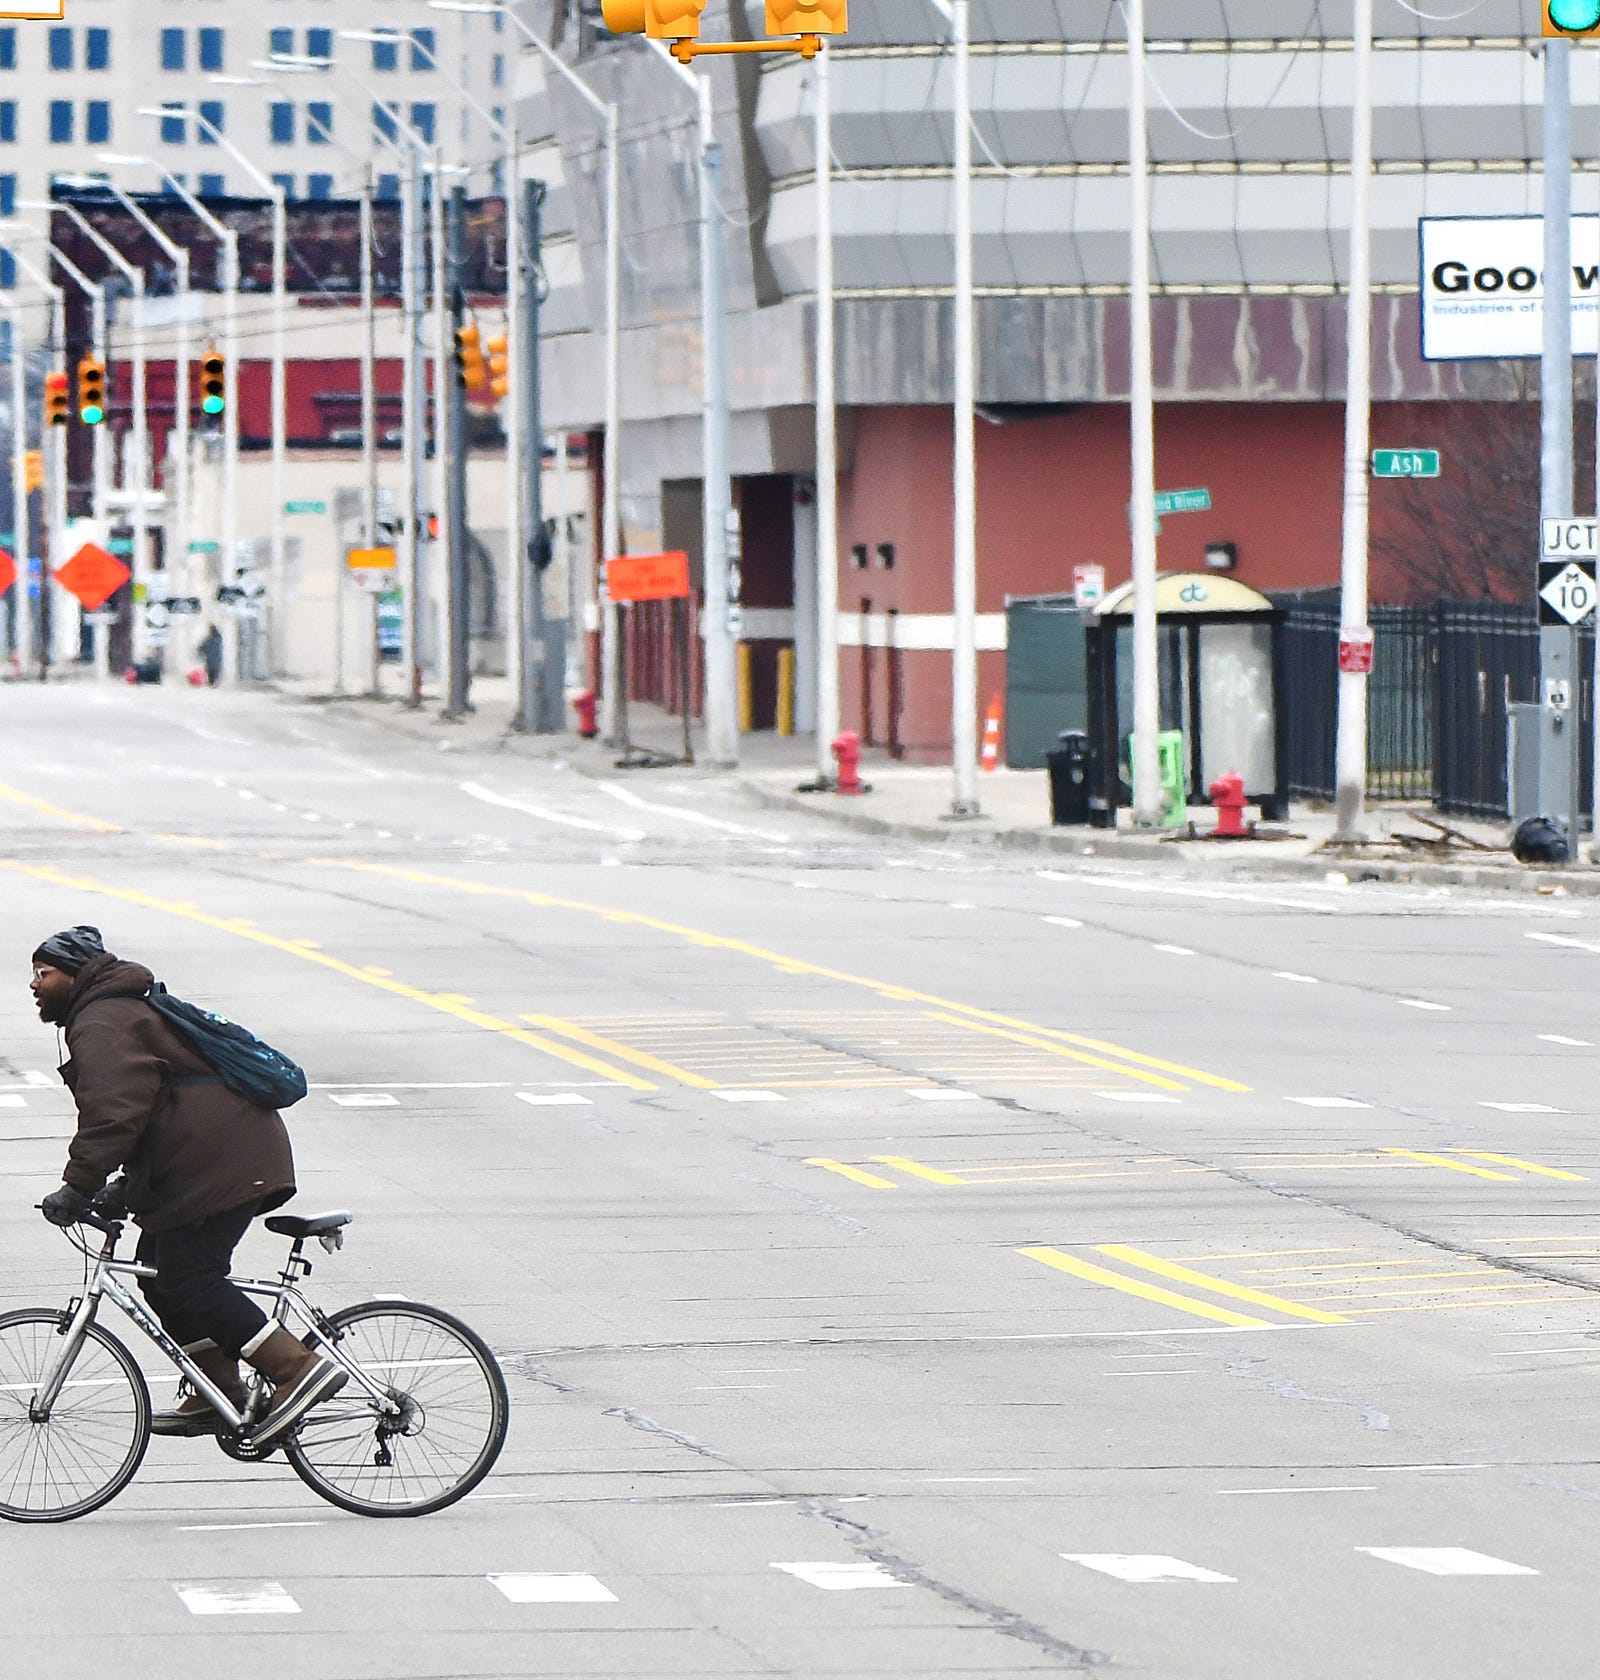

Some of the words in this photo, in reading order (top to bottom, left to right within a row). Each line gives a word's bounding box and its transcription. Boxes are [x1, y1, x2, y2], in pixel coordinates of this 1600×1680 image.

[1432, 261, 1599, 293] Goow
[1433, 302, 1514, 316] Industries
[1520, 302, 1537, 313] of
[1390, 454, 1423, 473] Ash
[1548, 524, 1599, 551] JCT
[1565, 572, 1580, 584] M
[1560, 585, 1588, 610] 10
